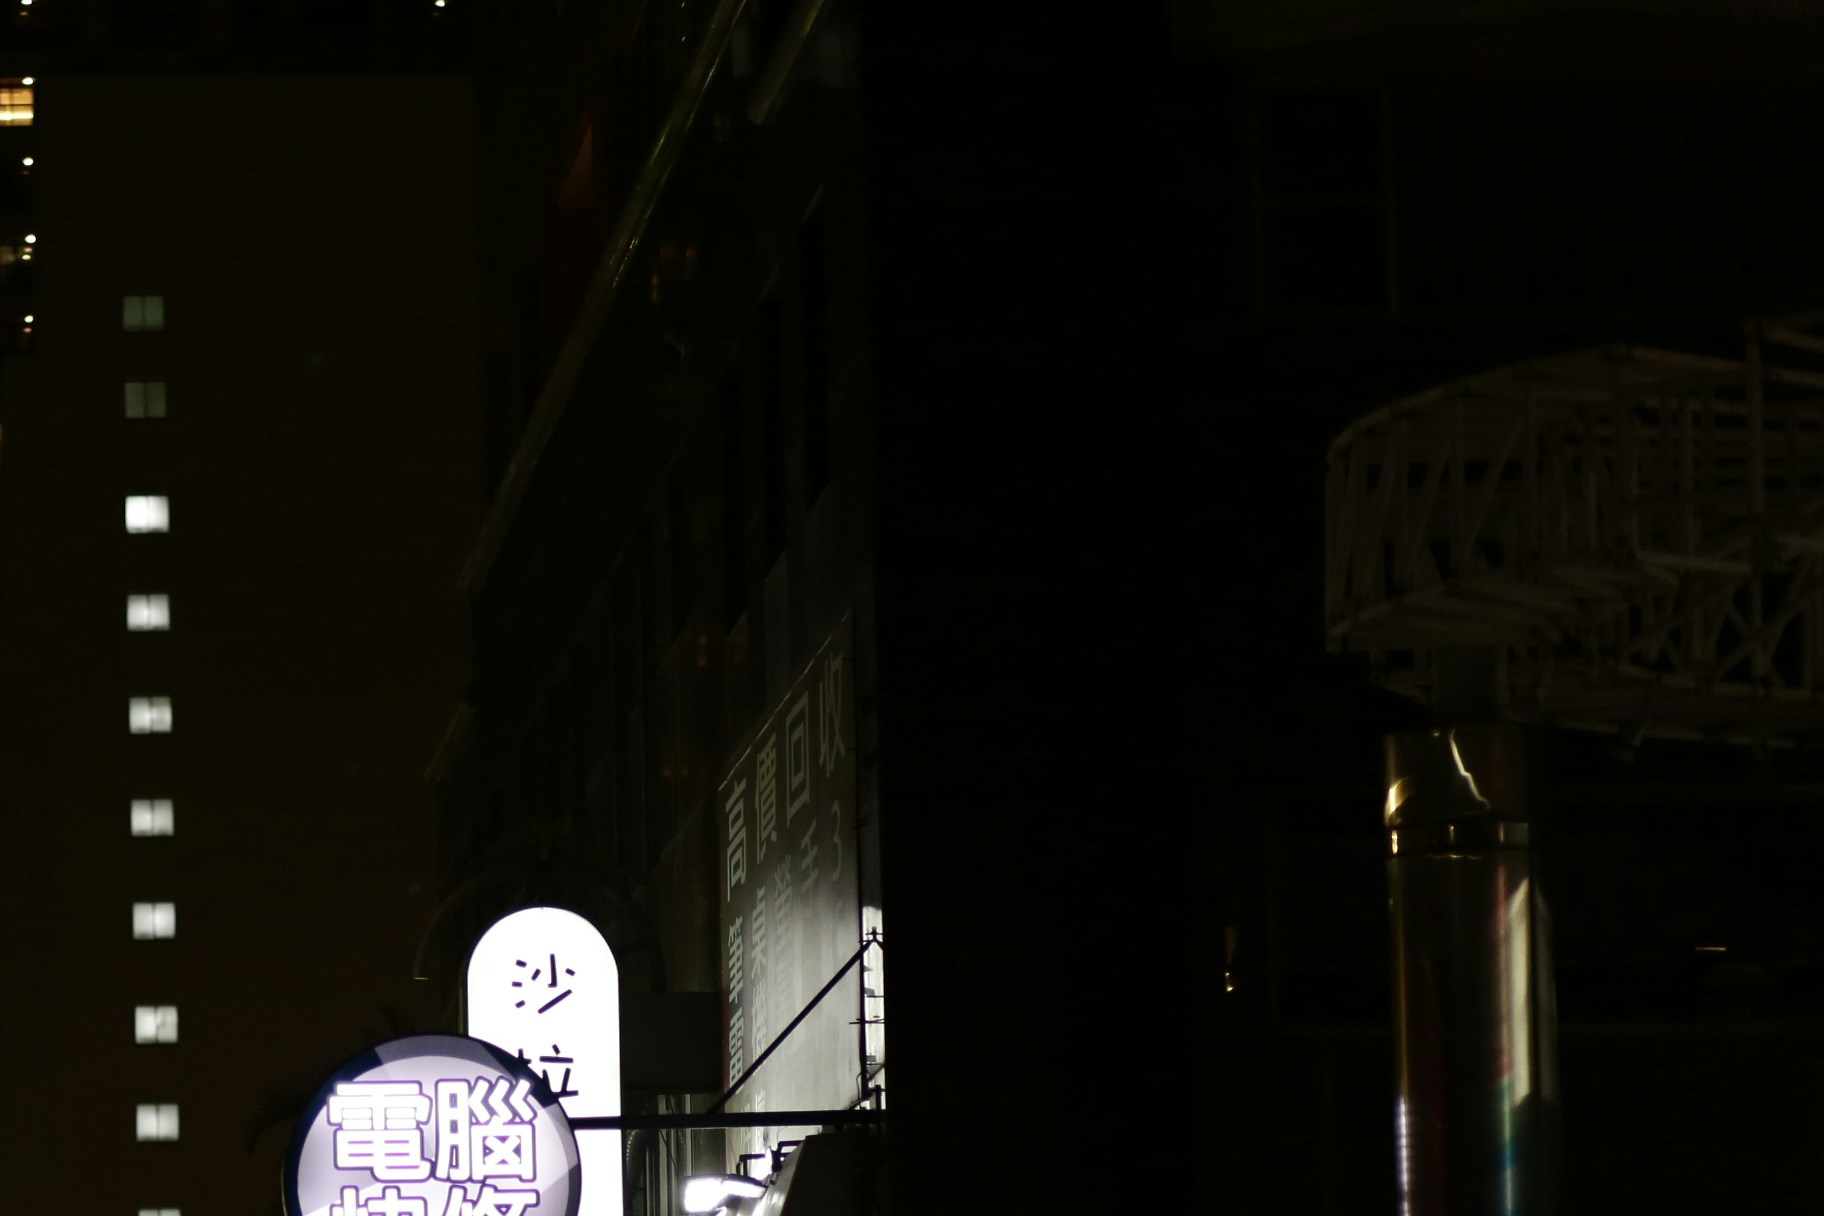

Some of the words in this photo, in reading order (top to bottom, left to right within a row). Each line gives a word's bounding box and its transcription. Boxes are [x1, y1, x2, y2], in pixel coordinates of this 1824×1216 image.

[725, 650, 847, 904] 高價回收
[326, 1076, 540, 1184] 電腦
